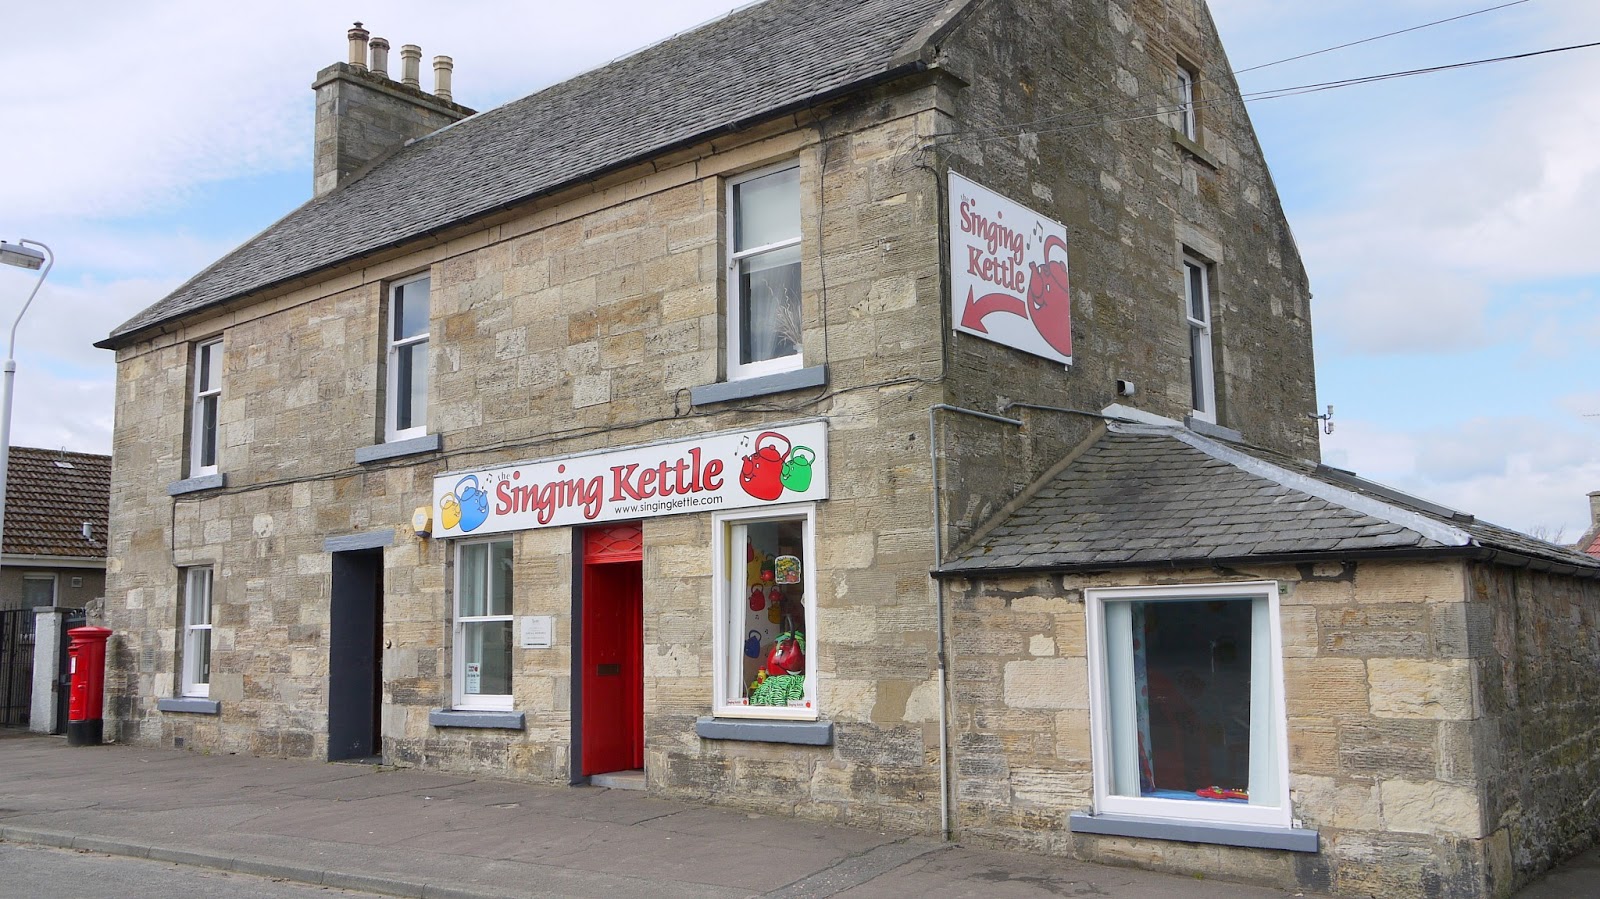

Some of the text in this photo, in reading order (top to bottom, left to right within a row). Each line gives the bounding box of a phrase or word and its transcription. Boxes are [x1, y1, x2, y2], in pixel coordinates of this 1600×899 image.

[960, 198, 1024, 266] Singing
[966, 244, 1026, 294] Kettle
[495, 446, 724, 525] Singing Kettle
[497, 471, 511, 481] the
[614, 495, 723, 514] www.singingkettle.com
